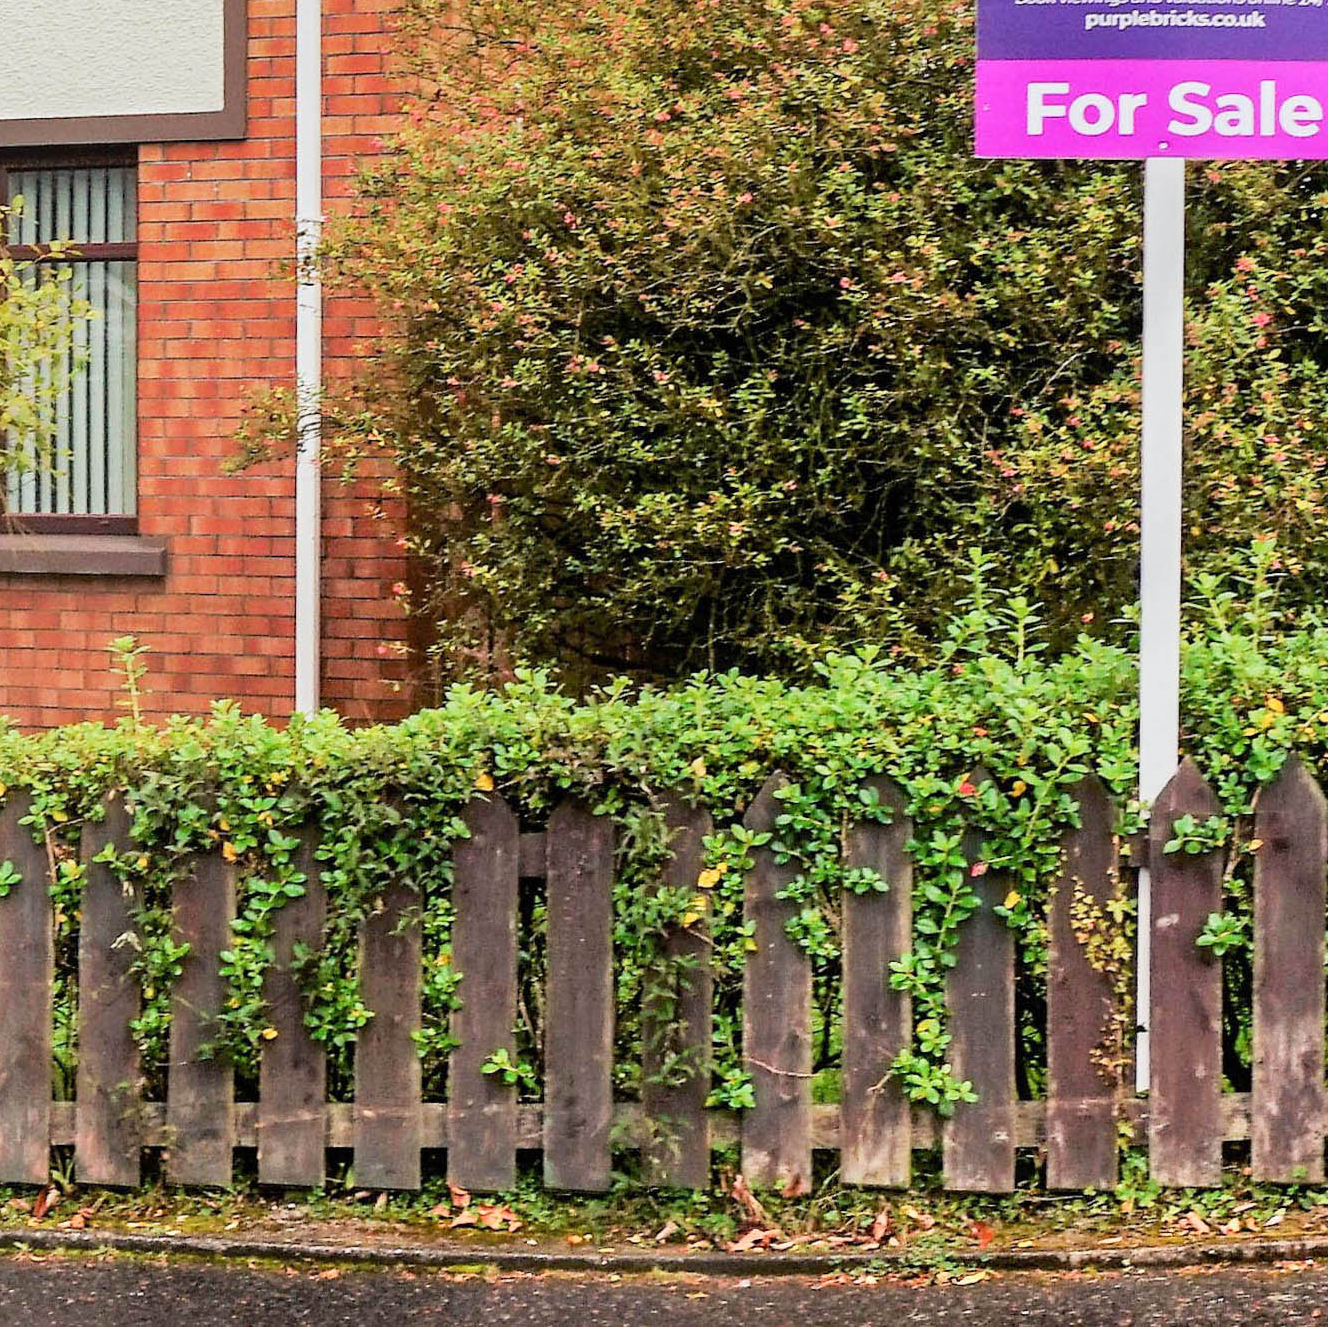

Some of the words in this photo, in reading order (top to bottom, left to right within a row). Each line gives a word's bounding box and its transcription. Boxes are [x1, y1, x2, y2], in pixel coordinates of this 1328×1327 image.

[1084, 9, 1265, 30] purplebricks.co.uk
[1027, 82, 1147, 137] For
[1168, 80, 1324, 138] Sale
